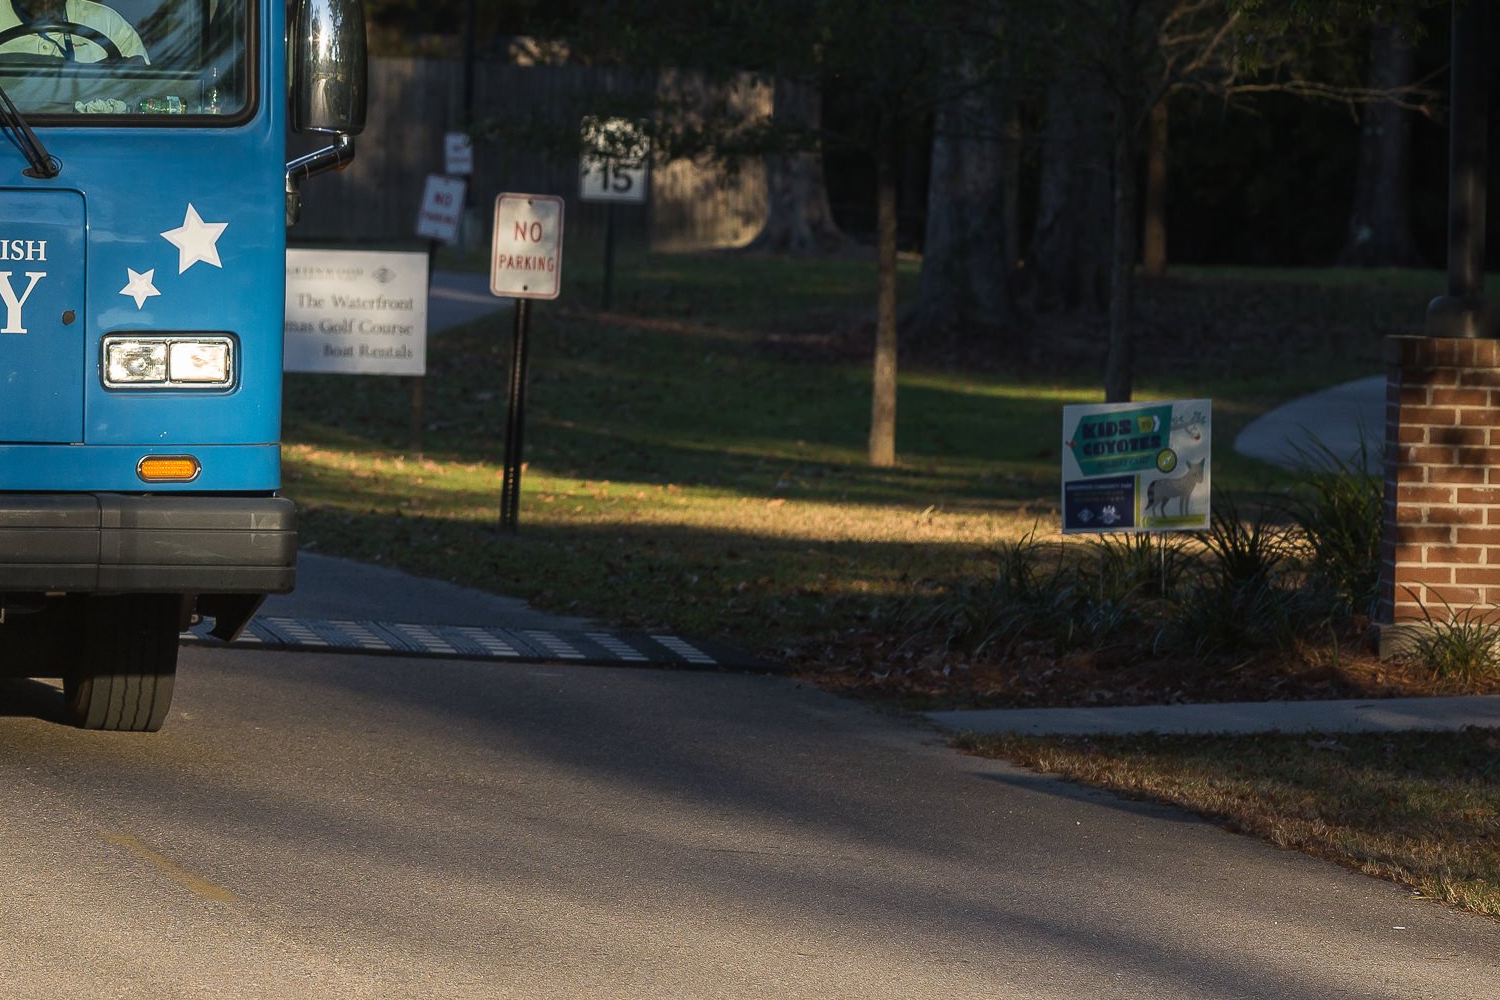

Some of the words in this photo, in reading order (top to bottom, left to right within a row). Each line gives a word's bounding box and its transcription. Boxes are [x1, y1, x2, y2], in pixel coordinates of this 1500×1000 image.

[602, 161, 633, 193] 15
[515, 221, 543, 243] NO
[499, 254, 555, 273] PARKING
[298, 292, 325, 309] The
[331, 294, 414, 310] Waterfront
[318, 318, 356, 335] Golf
[359, 320, 414, 336] Course
[323, 343, 354, 358] Boat
[359, 343, 414, 359] Rentals
[1083, 420, 1132, 438] KIDS
[1083, 435, 1161, 455] COYOTES
